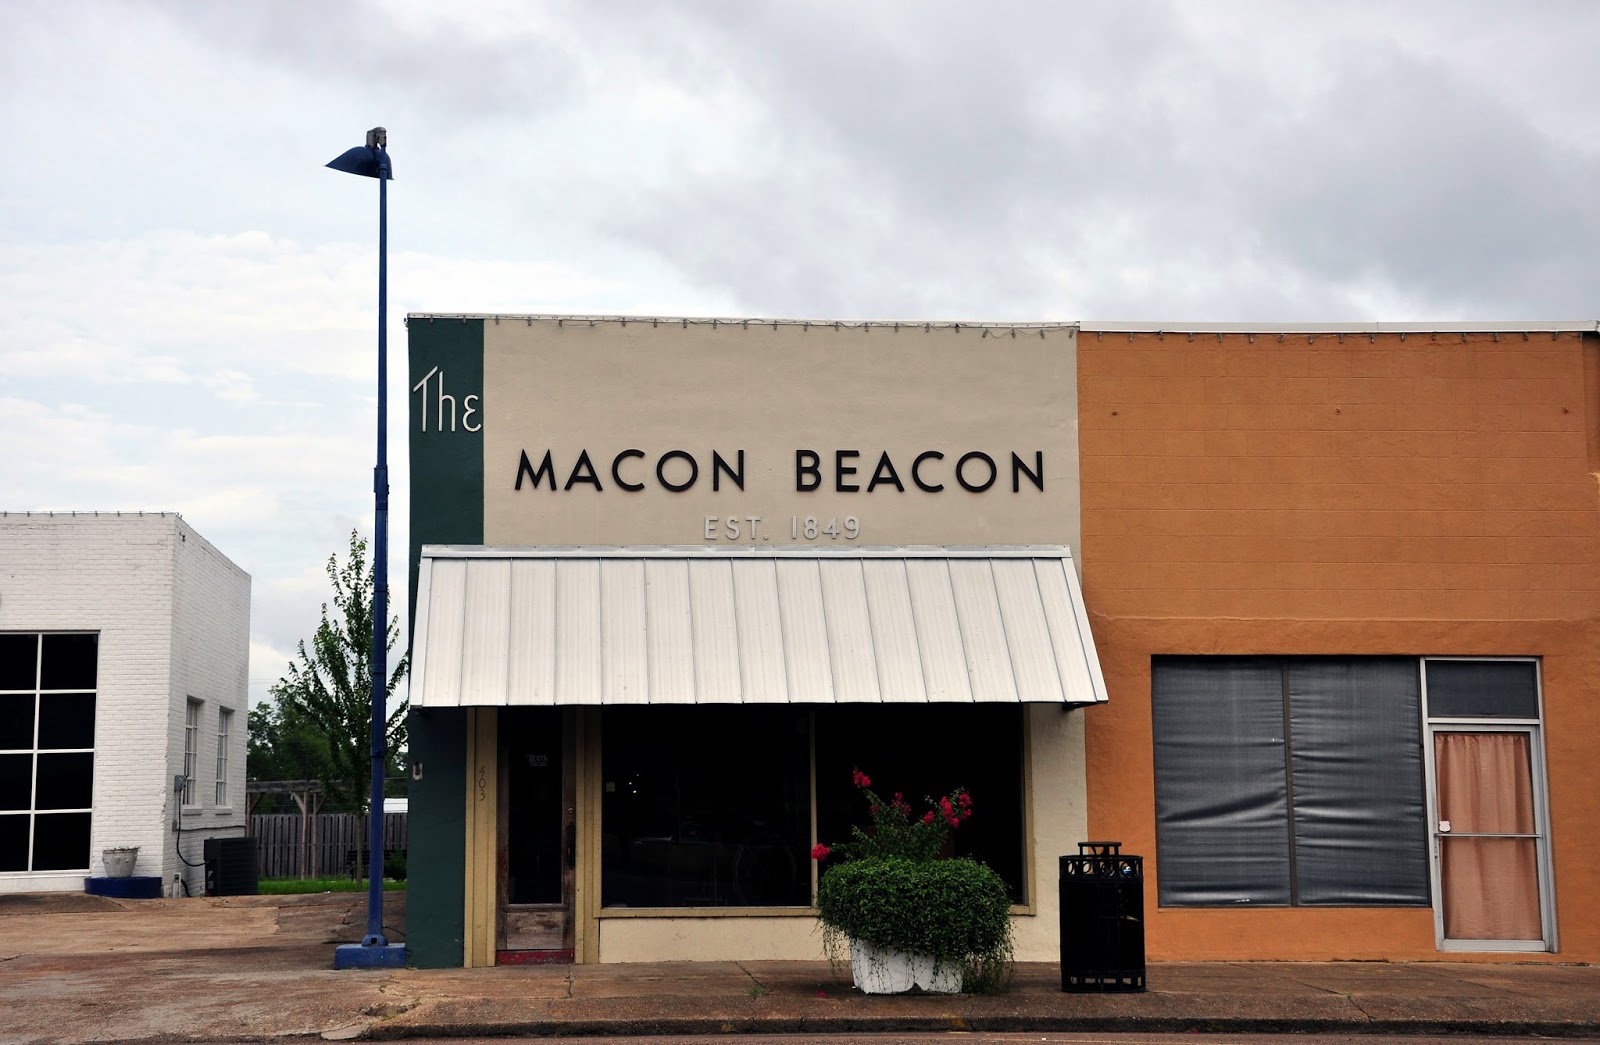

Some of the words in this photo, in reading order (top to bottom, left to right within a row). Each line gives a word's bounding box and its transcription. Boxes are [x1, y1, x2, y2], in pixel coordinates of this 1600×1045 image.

[515, 448, 745, 493] MACON
[796, 449, 1044, 494] BEACON
[704, 515, 769, 541] EST.
[791, 515, 860, 541] 1849
[478, 765, 487, 802] 403
